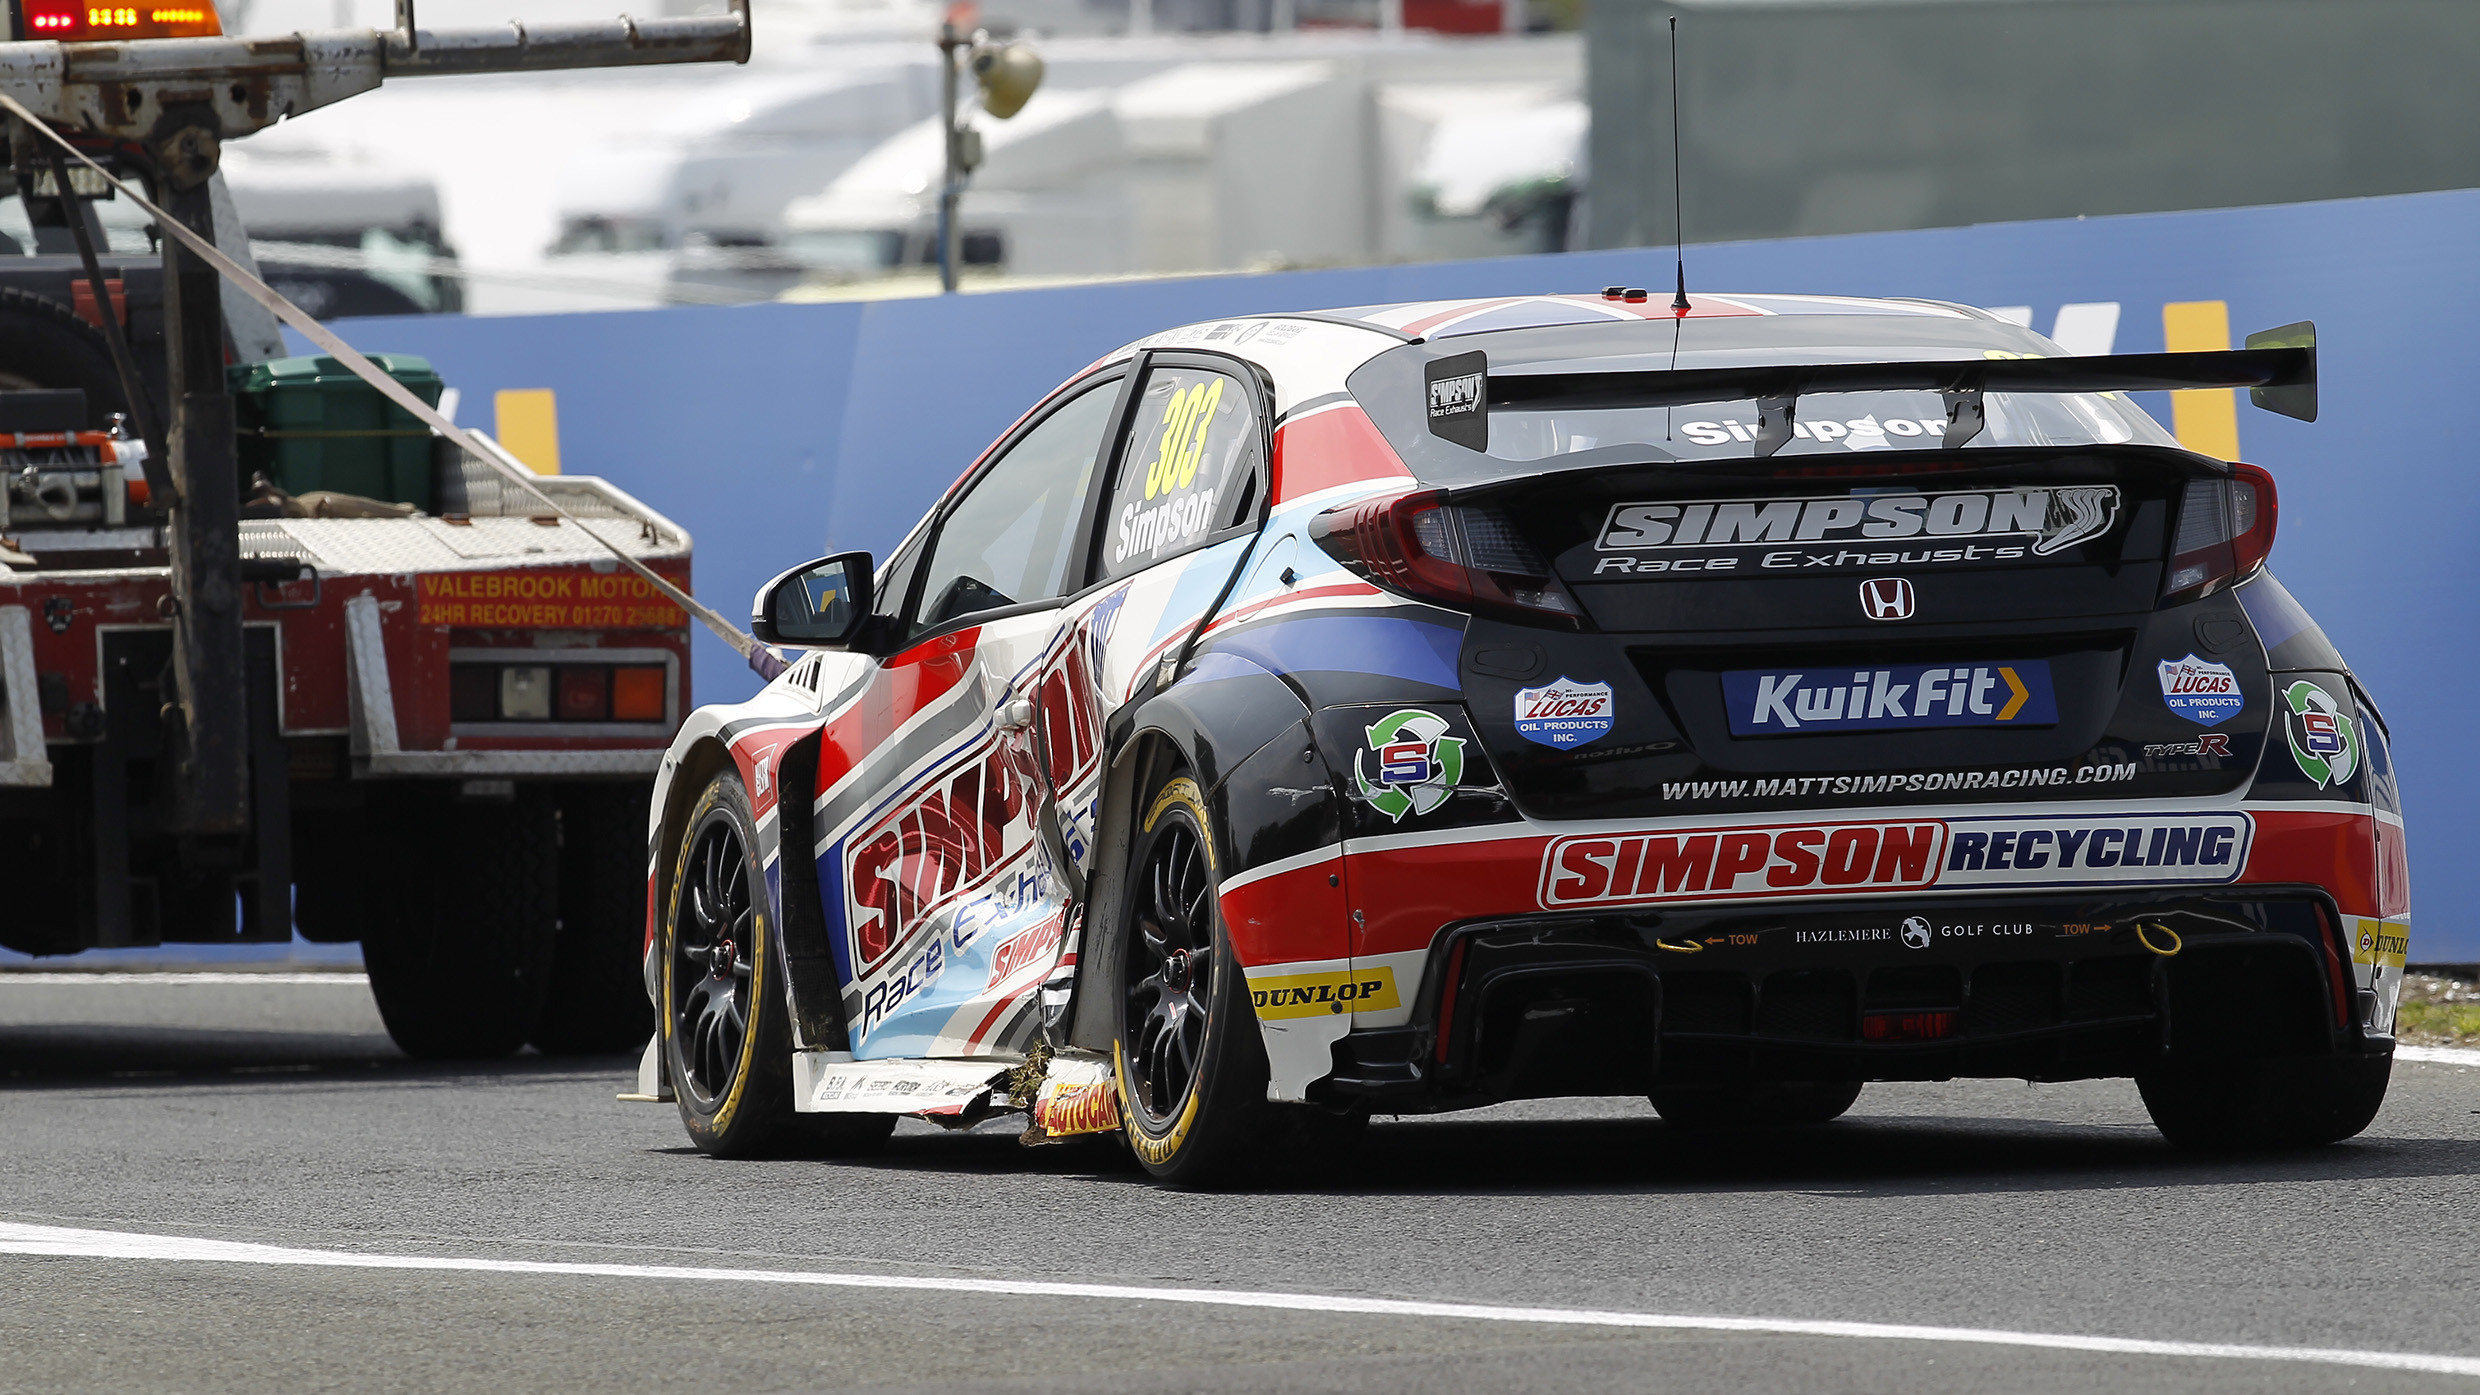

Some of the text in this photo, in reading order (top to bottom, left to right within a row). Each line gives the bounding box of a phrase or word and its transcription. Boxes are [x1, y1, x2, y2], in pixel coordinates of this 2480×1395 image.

[1431, 376, 1475, 406] SIMPSON
[1430, 408, 1445, 418] Race
[1145, 377, 1224, 501] 303
[1115, 487, 1215, 563] Simpson
[1605, 492, 2050, 546] SIMPSON
[1593, 544, 2026, 576] Race Exhausts
[424, 576, 682, 598] VALEBROOK MOTO
[421, 605, 466, 625] 24HR
[470, 604, 568, 625] RECOVERY
[572, 605, 622, 625] 01270
[2171, 676, 2232, 694] LUCAS
[1525, 698, 1606, 718] LUCAS
[1752, 667, 1997, 728] KwikFit
[2169, 698, 2241, 708] OIL PRODUCTS
[2198, 710, 2219, 719] INC.
[1519, 720, 1609, 732] OIL PRODUCTS
[1553, 733, 1578, 742] INC.
[1662, 762, 2137, 801] WWW.MATTSIMPSONRACING.COM
[1552, 825, 2236, 901] SIMPSON RECYCLING
[1795, 923, 2034, 943] HAZLEMERE GOLF CLUB
[2063, 923, 2091, 935] TOW
[1728, 934, 1758, 946] TOW
[860, 939, 943, 1044] Race
[1252, 980, 1383, 1008] DUNLOP
